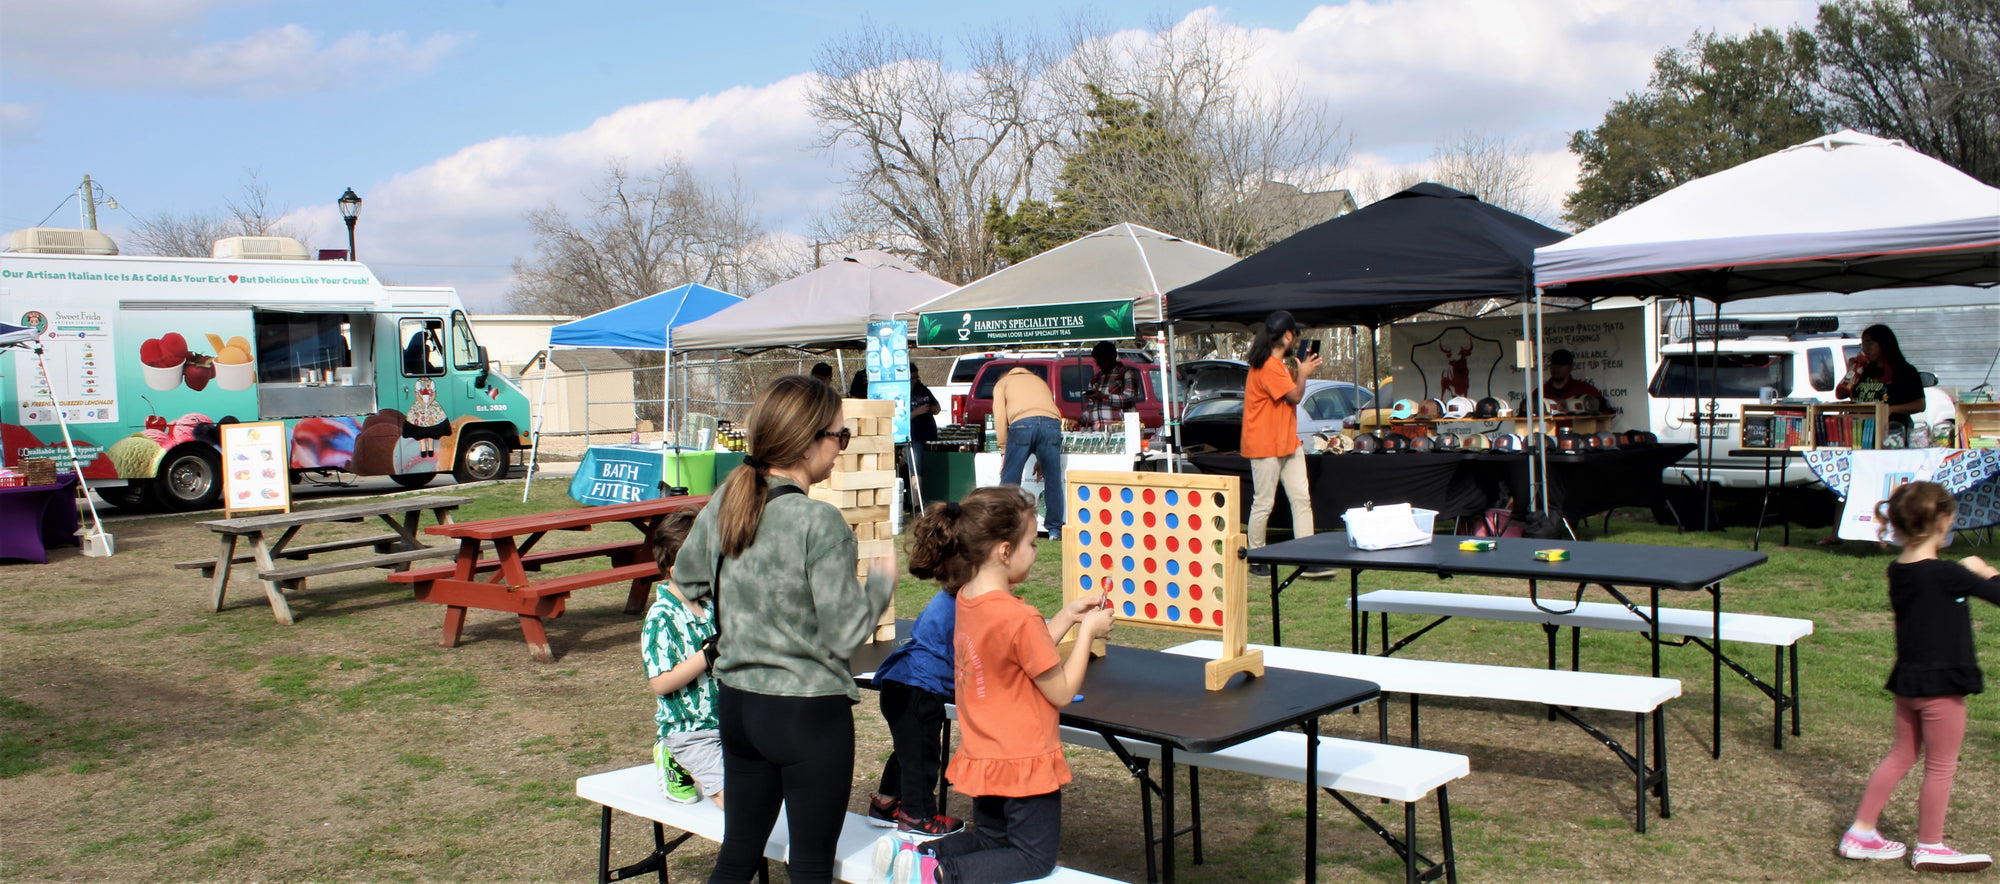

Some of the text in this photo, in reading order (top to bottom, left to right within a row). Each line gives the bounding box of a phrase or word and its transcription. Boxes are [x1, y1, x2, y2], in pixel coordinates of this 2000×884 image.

[2, 269, 24, 278] Our
[26, 270, 66, 280] Artisan
[67, 271, 103, 281] Italian
[104, 273, 119, 281] Ice
[121, 273, 130, 281] Is
[131, 273, 144, 281] As
[146, 274, 168, 282] Cold
[170, 274, 182, 282] As
[184, 275, 207, 283] Your
[208, 275, 227, 284] Ex's
[240, 276, 256, 284] But
[258, 276, 299, 284] Delicious
[301, 276, 319, 284] Like
[342, 277, 369, 285] Crush!
[56, 311, 101, 321] Sweet Frida
[974, 315, 1084, 331] HARIN'S SPECIALITY TEAS
[1576, 323, 1601, 334] PATCH
[1602, 322, 1625, 333] HATS
[1572, 350, 1609, 360] AVAILABLE
[27, 447, 55, 455] vailable
[602, 462, 639, 481] BATH
[591, 482, 641, 502] FITTER
